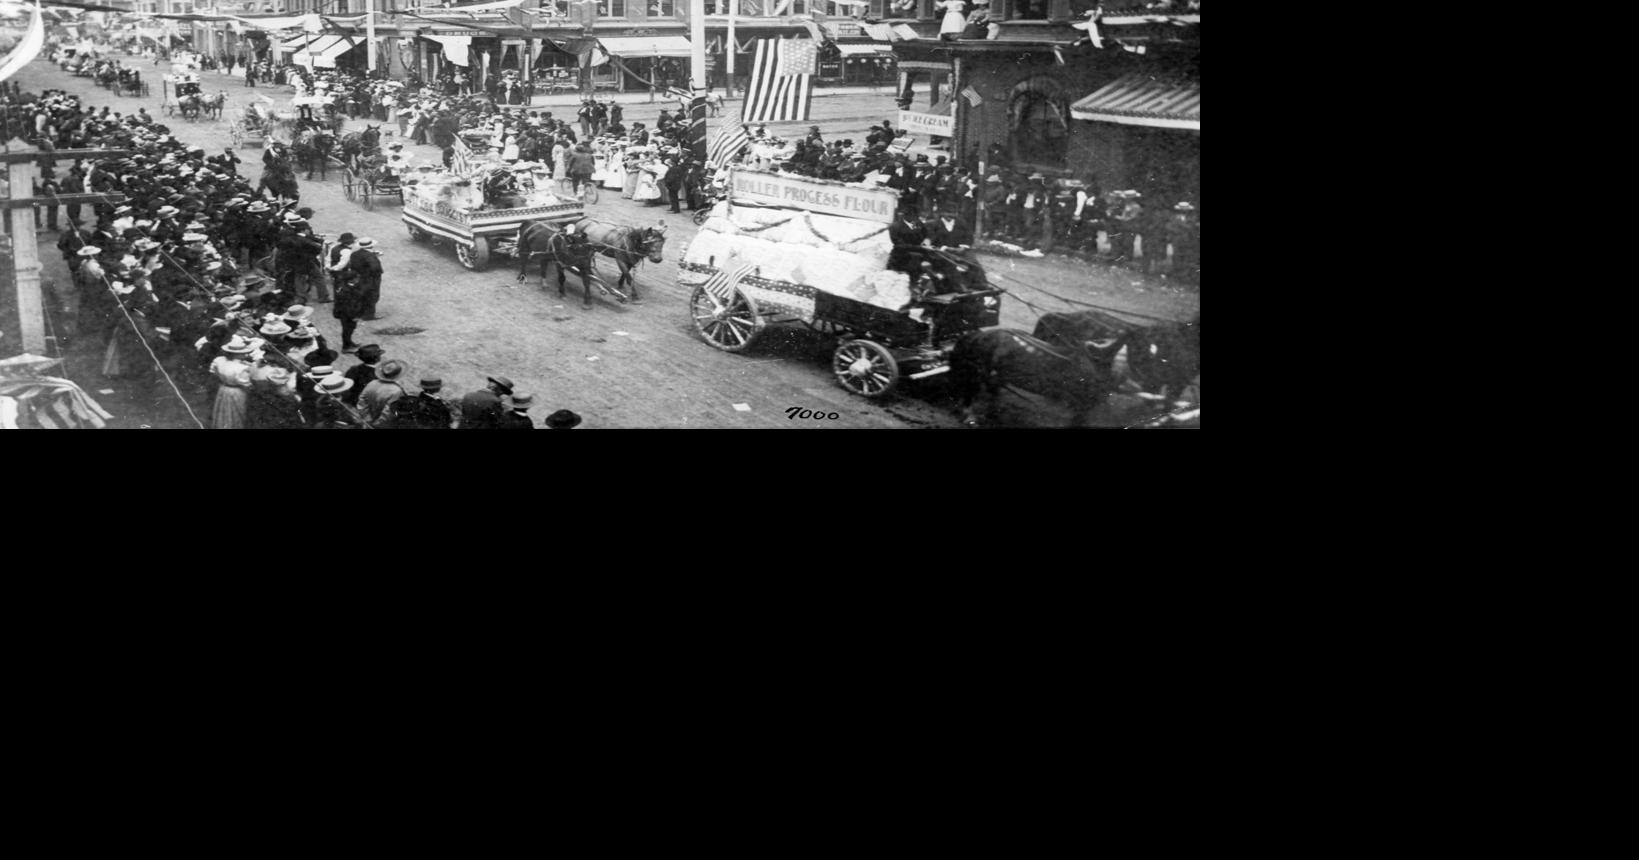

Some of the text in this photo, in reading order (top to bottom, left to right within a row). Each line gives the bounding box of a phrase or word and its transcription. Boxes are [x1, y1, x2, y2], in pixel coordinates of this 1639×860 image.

[735, 178, 890, 216] ROLLER PROCESS FLOUR
